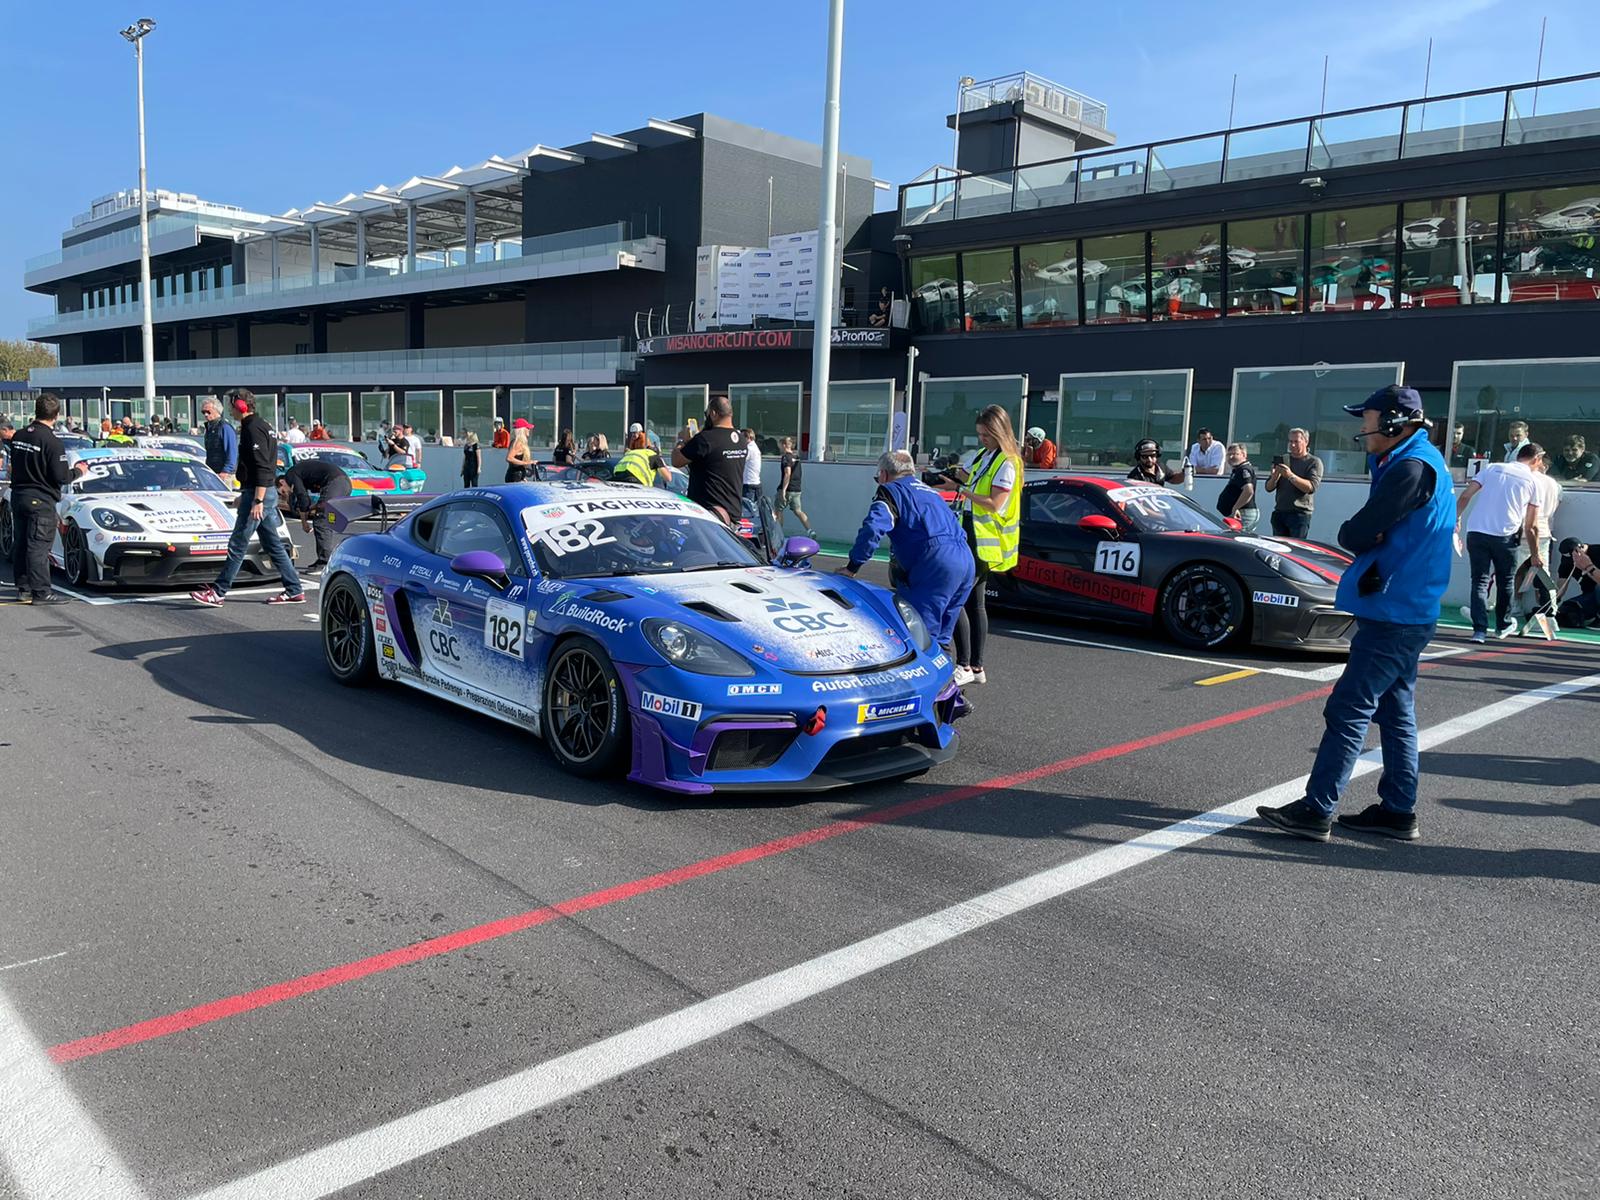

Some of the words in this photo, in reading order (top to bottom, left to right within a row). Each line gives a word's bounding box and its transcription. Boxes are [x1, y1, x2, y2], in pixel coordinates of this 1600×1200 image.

[666, 331, 793, 351] MISANOCIRCUIT.COM
[527, 518, 618, 557] 182
[1100, 549, 1135, 572] 116
[1026, 560, 1057, 582] First
[1062, 569, 1147, 606] Rennsport
[1254, 592, 1283, 604] Mobil
[565, 603, 628, 634] BuildRock
[773, 611, 849, 633] CBC
[430, 629, 460, 661] CBC
[489, 614, 522, 656] 182
[730, 684, 780, 695] OMCN
[642, 693, 680, 715] Mobil
[877, 703, 916, 716] MICHELIN
